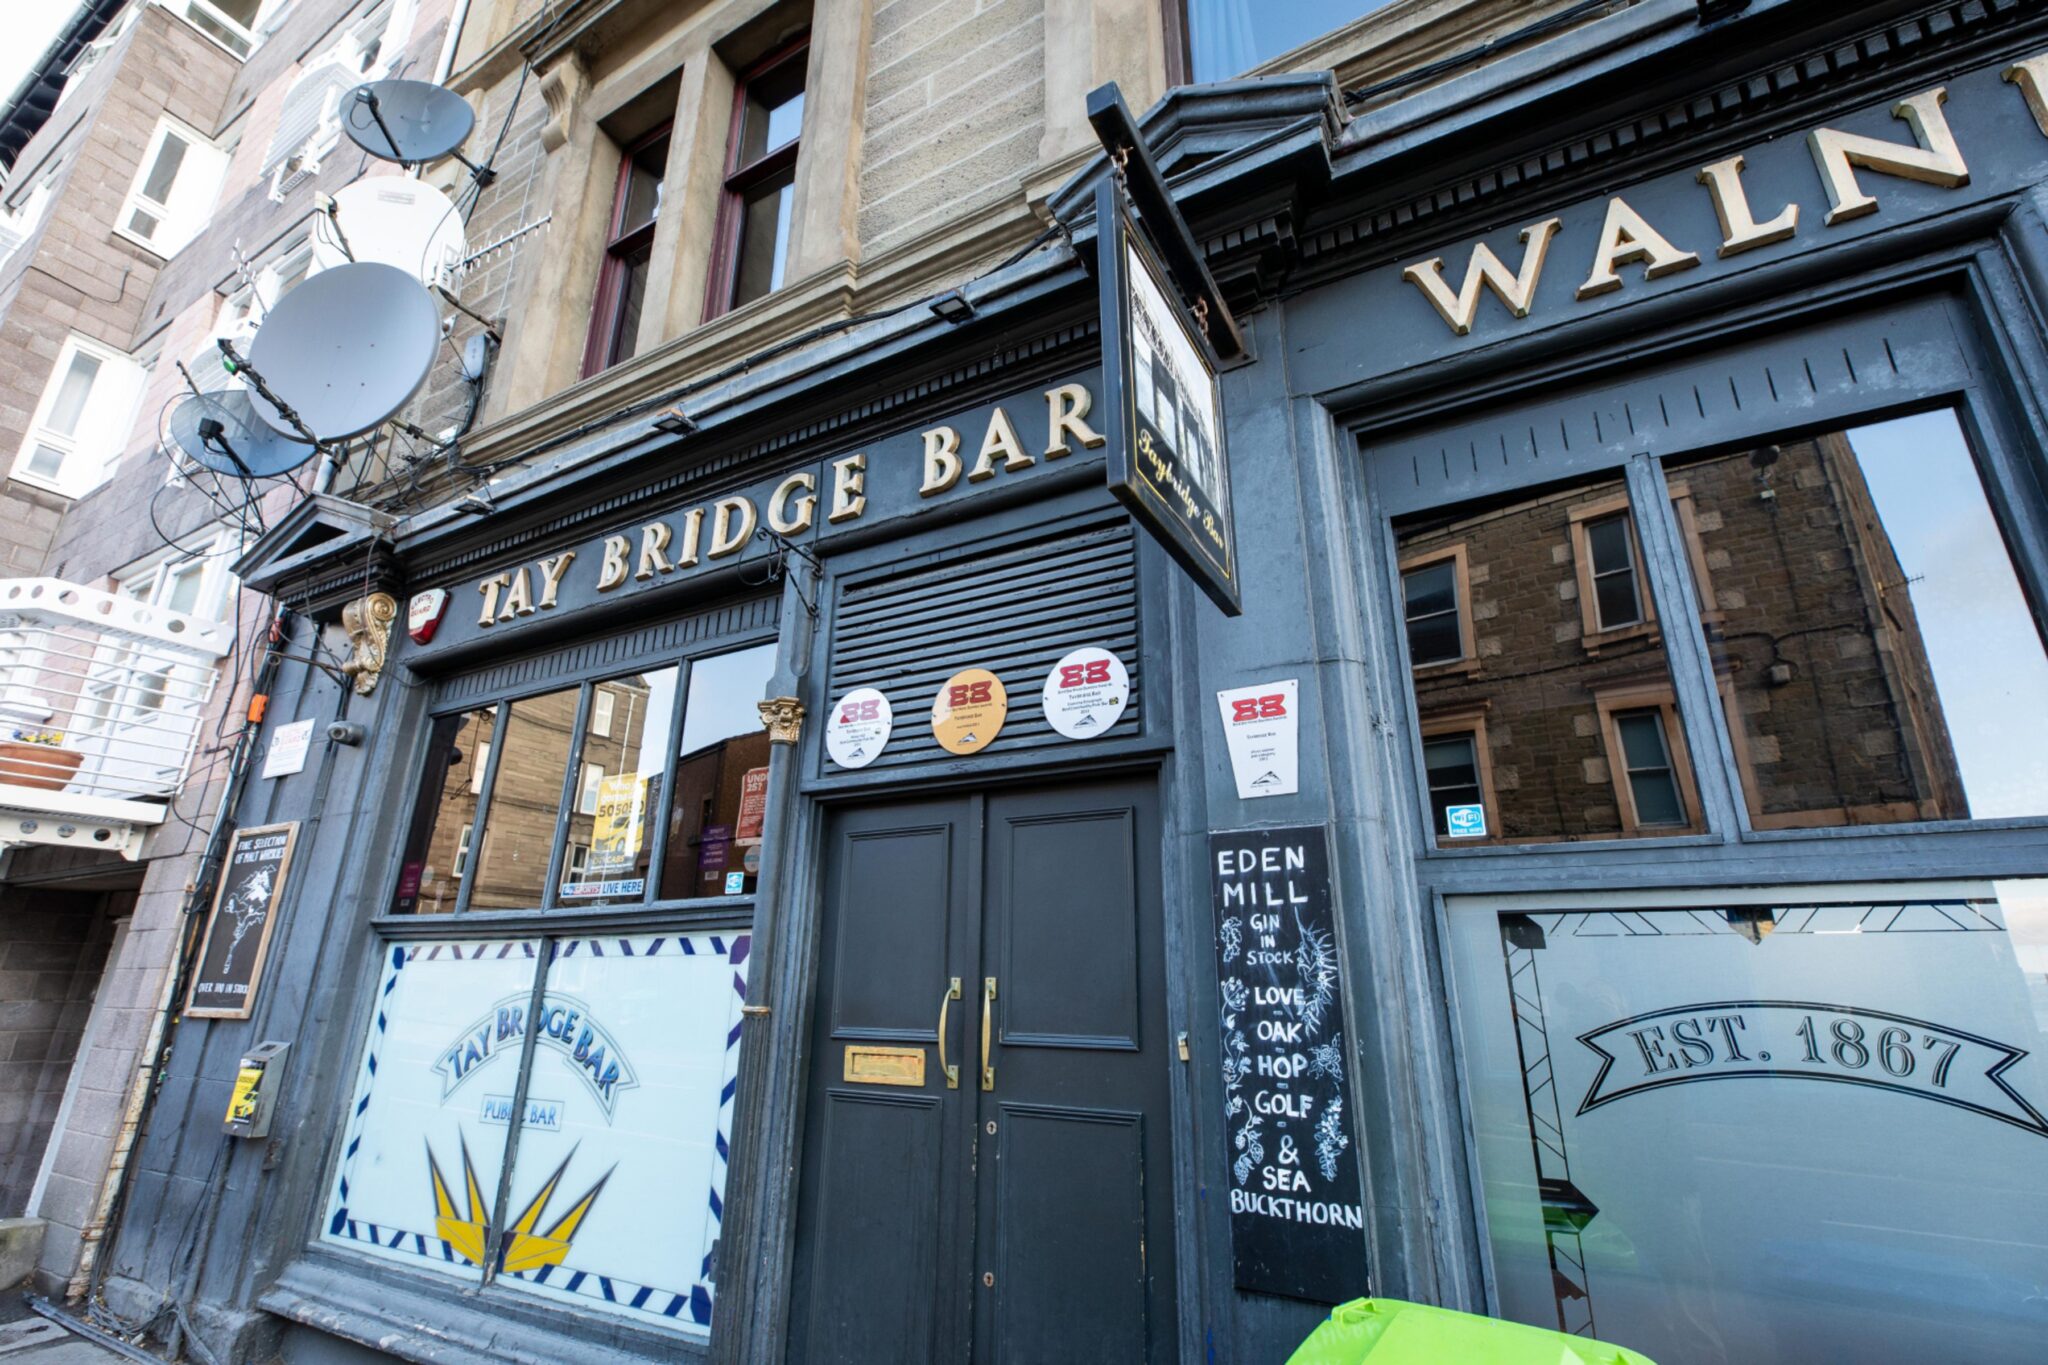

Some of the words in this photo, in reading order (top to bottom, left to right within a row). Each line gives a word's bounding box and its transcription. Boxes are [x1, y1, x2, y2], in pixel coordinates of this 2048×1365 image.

[1138, 428, 1201, 520] Taybridge
[1203, 508, 1225, 550] Bar
[477, 550, 577, 628] TAY
[597, 453, 867, 593] BRIDGE
[919, 382, 1106, 498] BAR
[747, 773, 769, 784] UND
[1217, 845, 1305, 875] EDEN
[602, 882, 620, 894] LIVE
[621, 880, 643, 892] HERE
[1222, 880, 1309, 907] MILL
[1250, 913, 1280, 932] GIN
[1260, 935, 1276, 948] IN
[1246, 950, 1294, 966] STOCK
[1254, 986, 1307, 1006] LOVE
[1257, 1020, 1303, 1043] OAK
[447, 1023, 492, 1080] TAY
[496, 1003, 579, 1044] BRDGE
[572, 1022, 620, 1101] BAR
[1626, 1014, 1772, 1077] EST.
[1794, 1014, 1962, 1088] 1867
[1257, 1053, 1309, 1079] HOP
[484, 1100, 526, 1122] PUBL
[529, 1104, 556, 1126] BAR
[1254, 1090, 1314, 1118] GOLF
[1278, 1134, 1300, 1165] &
[1262, 1165, 1312, 1192] SEA
[1230, 1188, 1363, 1230] BUCKTHORN
